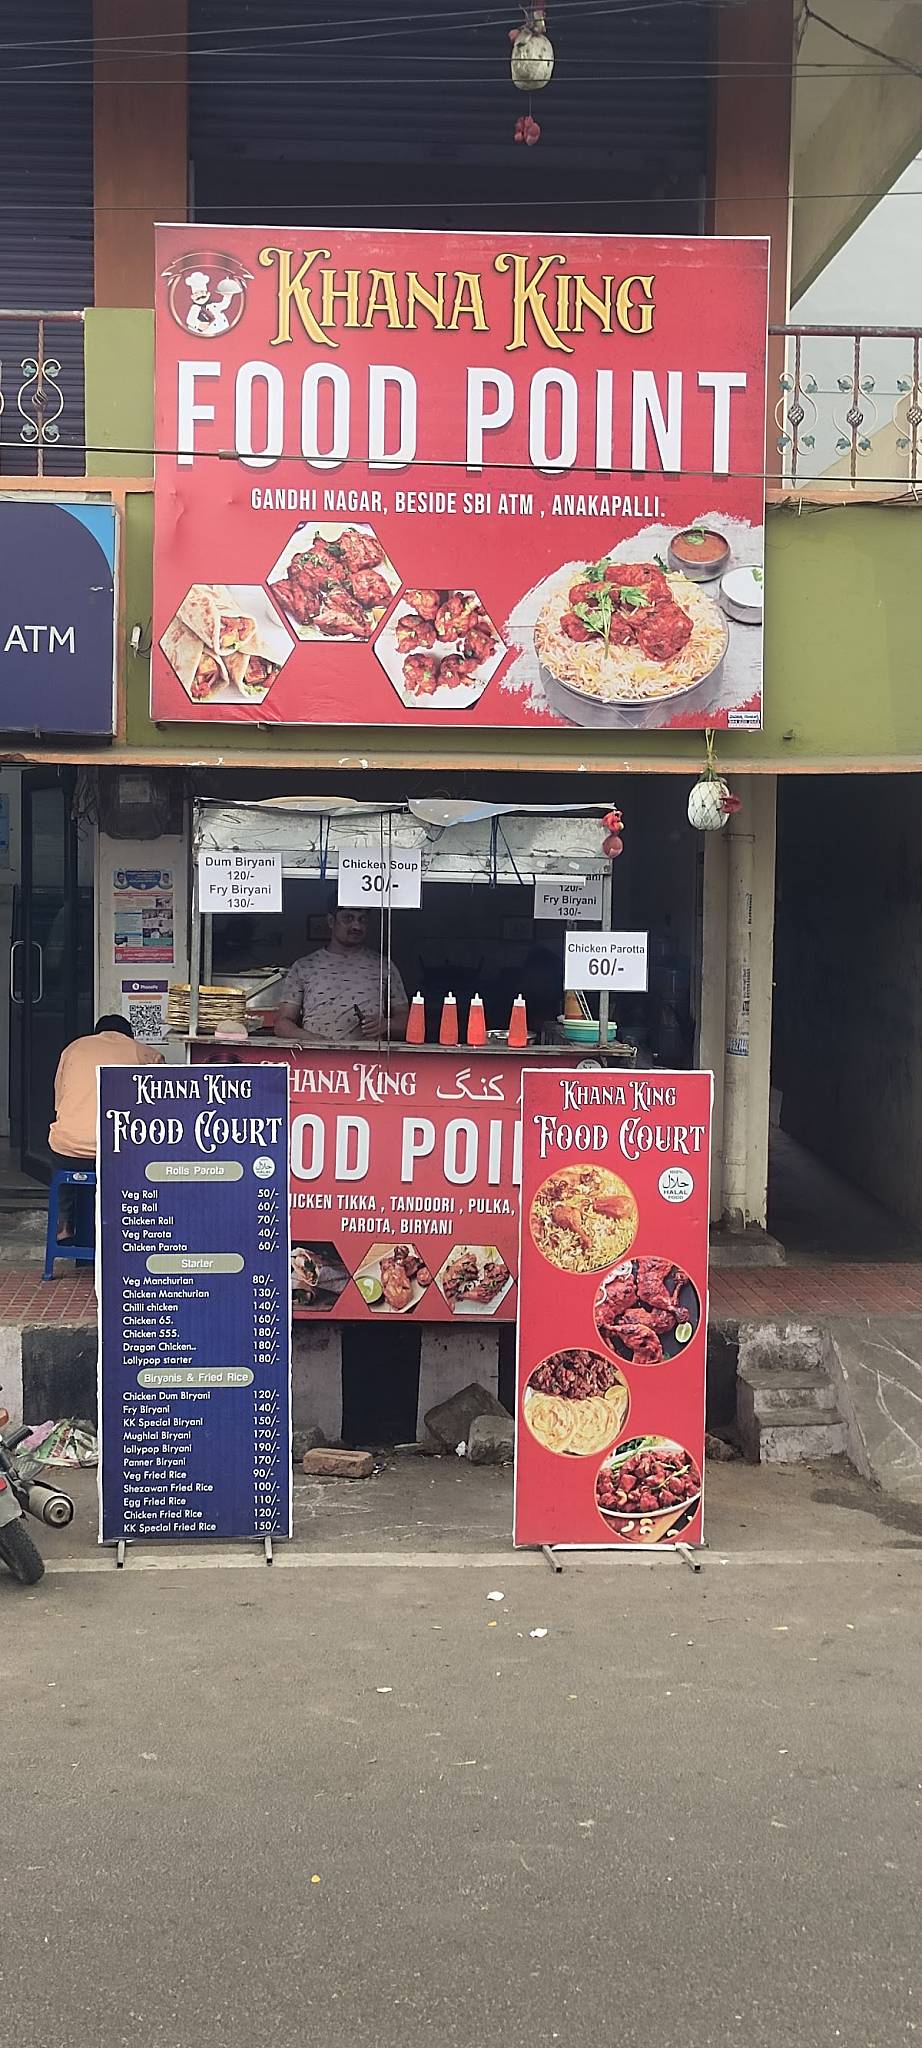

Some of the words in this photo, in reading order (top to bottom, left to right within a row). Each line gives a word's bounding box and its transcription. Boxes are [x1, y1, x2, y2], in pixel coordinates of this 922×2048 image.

[258, 246, 489, 348] KHANA
[494, 252, 655, 353] KING
[176, 360, 418, 470] FOOD
[465, 366, 747, 475] POINT
[251, 487, 317, 511] GANDHI
[324, 489, 388, 515] NAGAR,
[395, 491, 457, 514] BESIDE
[462, 492, 491, 514] SBI
[497, 493, 533, 515] ATM
[551, 494, 666, 518] ANAKAPALLI.
[4, 624, 76, 654] ATM
[205, 856, 231, 867] Dum
[235, 856, 275, 870] Biryani
[342, 859, 386, 870] Chicken
[389, 860, 418, 872] Soup
[227, 871, 255, 881] 120/-
[361, 875, 399, 892] 30/-
[209, 885, 228, 897] Fry
[231, 884, 271, 898] Biryani
[227, 898, 255, 908] 130/-
[543, 895, 559, 905] Fry
[562, 895, 597, 906] Biryani
[558, 907, 582, 916] 130/-
[568, 943, 607, 953] Chicken
[610, 944, 645, 954] Parotta
[588, 958, 625, 977] 60/-
[132, 1074, 200, 1105] KHANA
[203, 1074, 252, 1105] KING
[288, 1068, 351, 1094] HANA
[352, 1063, 416, 1103] KING
[559, 1080, 626, 1111] KHANA
[628, 1081, 677, 1112] KING
[106, 1109, 184, 1153] FOOD
[194, 1109, 283, 1154] COURT
[533, 1114, 609, 1159] FOOD
[618, 1116, 705, 1161] COURT
[165, 1166, 190, 1176] Rolls
[193, 1166, 225, 1176] Parota
[121, 1190, 140, 1200] Veg
[142, 1189, 158, 1199] Roll
[257, 1188, 279, 1199] 50/-
[121, 1203, 139, 1214] Egg
[142, 1203, 158, 1212] Roll
[257, 1201, 279, 1213] 60/-
[337, 1194, 377, 1211] TIKKA
[390, 1196, 454, 1213] TANDOORI
[468, 1198, 516, 1217] PULKA,
[121, 1216, 156, 1226] Chicken
[158, 1216, 174, 1225] Roll
[257, 1214, 280, 1226] 70/-
[341, 1217, 396, 1235] PAROTA,
[400, 1219, 454, 1235] BIRYANI
[121, 1230, 140, 1240] Veg
[142, 1229, 172, 1239] Parota
[258, 1228, 280, 1239] 40/-
[122, 1242, 156, 1252] Chicken
[158, 1242, 188, 1252] Parota
[258, 1241, 280, 1252] 60/-
[181, 1258, 214, 1269] Starter
[122, 1276, 141, 1287] Veg
[143, 1276, 194, 1285] Manchurian
[252, 1274, 274, 1286] 80/-
[122, 1289, 157, 1299] Chicken
[158, 1289, 210, 1298] Manchurian
[253, 1287, 280, 1299] 130/-
[122, 1303, 145, 1312] Chilli
[146, 1302, 178, 1312] chicken
[253, 1300, 280, 1312] 140/-
[122, 1316, 157, 1325] Chicken
[158, 1315, 174, 1325] 65.
[253, 1313, 280, 1325] 160/-
[122, 1329, 157, 1338] Chicken
[158, 1329, 180, 1338] 555.
[253, 1327, 280, 1339] 180/-
[123, 1342, 156, 1353] Dragon
[253, 1340, 280, 1352] 180/-
[123, 1356, 161, 1366] Lollypop
[163, 1356, 193, 1364] starter
[253, 1353, 280, 1365] 180/-
[143, 1373, 182, 1384] Biryanis
[186, 1373, 194, 1382] &
[198, 1372, 223, 1382] Fried
[227, 1372, 249, 1382] Rice
[122, 1391, 157, 1401] Chicken
[158, 1392, 178, 1400] Dum
[180, 1391, 211, 1401] Biryani
[253, 1389, 280, 1401] 120/-
[123, 1405, 137, 1415] Fry
[140, 1404, 170, 1415] Biryani
[253, 1402, 280, 1414] 140/-
[123, 1418, 136, 1427] KK
[138, 1418, 171, 1429] Special
[173, 1417, 203, 1428] Biryani
[253, 1415, 280, 1427] 150/-
[123, 1431, 159, 1442] Mughlai
[161, 1431, 191, 1441] Biryani
[253, 1428, 280, 1440] 170/-
[162, 1444, 192, 1454] Biryani
[253, 1441, 280, 1453] 190/-
[123, 1458, 153, 1467] Panner
[156, 1457, 186, 1468] Biryani
[253, 1454, 280, 1467] 170/-
[123, 1471, 141, 1482] Veg
[143, 1470, 166, 1480] Fried
[168, 1470, 187, 1479] Rice
[253, 1468, 274, 1480] 90/-
[123, 1484, 168, 1493] Shezawan
[170, 1483, 193, 1492] Fried
[195, 1483, 214, 1492] Rice
[254, 1480, 280, 1493] 100/-
[123, 1497, 141, 1508] Egg
[143, 1497, 166, 1506] Fried
[168, 1496, 186, 1505] Rice
[254, 1493, 280, 1506] 110/-
[123, 1510, 157, 1520] Chicken
[159, 1510, 182, 1519] Fried
[184, 1509, 203, 1518] Rice
[254, 1507, 280, 1519] 120/-
[123, 1524, 136, 1533] KK
[139, 1522, 171, 1534] Special
[173, 1522, 196, 1531] Fried
[198, 1522, 216, 1531] Rice
[254, 1520, 280, 1532] 150/-
